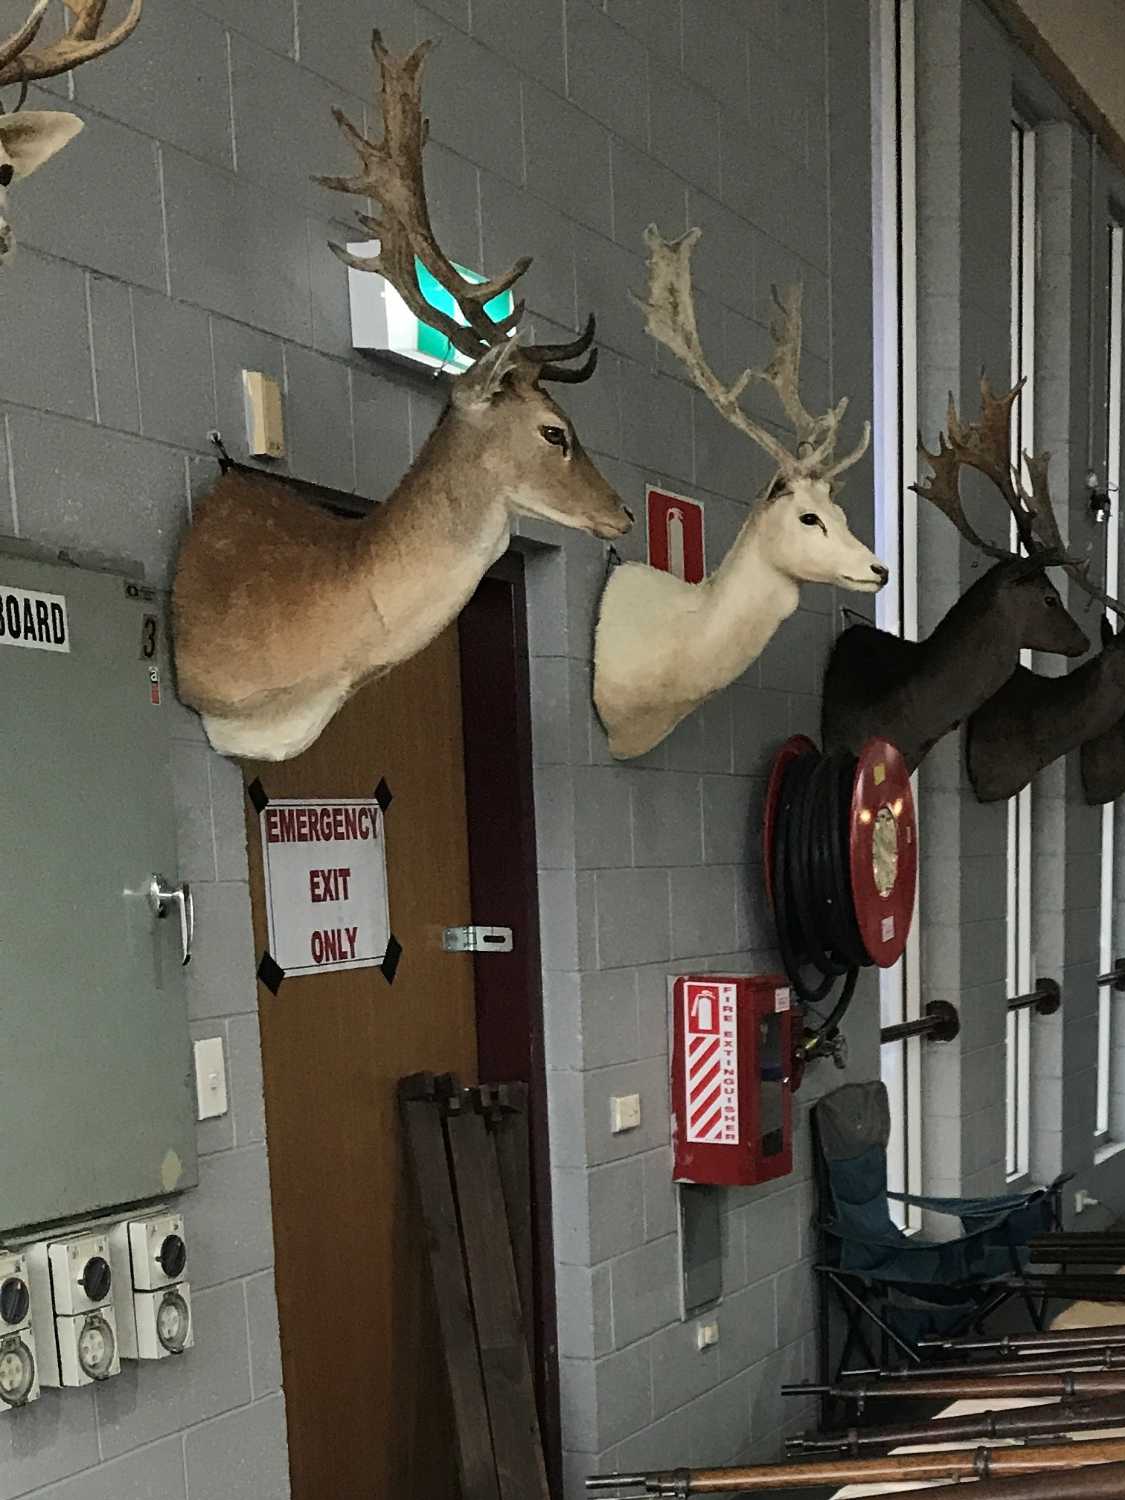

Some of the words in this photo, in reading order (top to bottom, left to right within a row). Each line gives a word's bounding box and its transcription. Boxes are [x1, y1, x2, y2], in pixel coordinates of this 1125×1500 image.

[143, 617, 156, 658] 3
[266, 807, 378, 843] EMERGENCY
[309, 868, 351, 903] EXIT
[311, 927, 358, 964] ONLY
[723, 987, 733, 1022] FIRE
[724, 1031, 736, 1141] EXTINGUISHER
